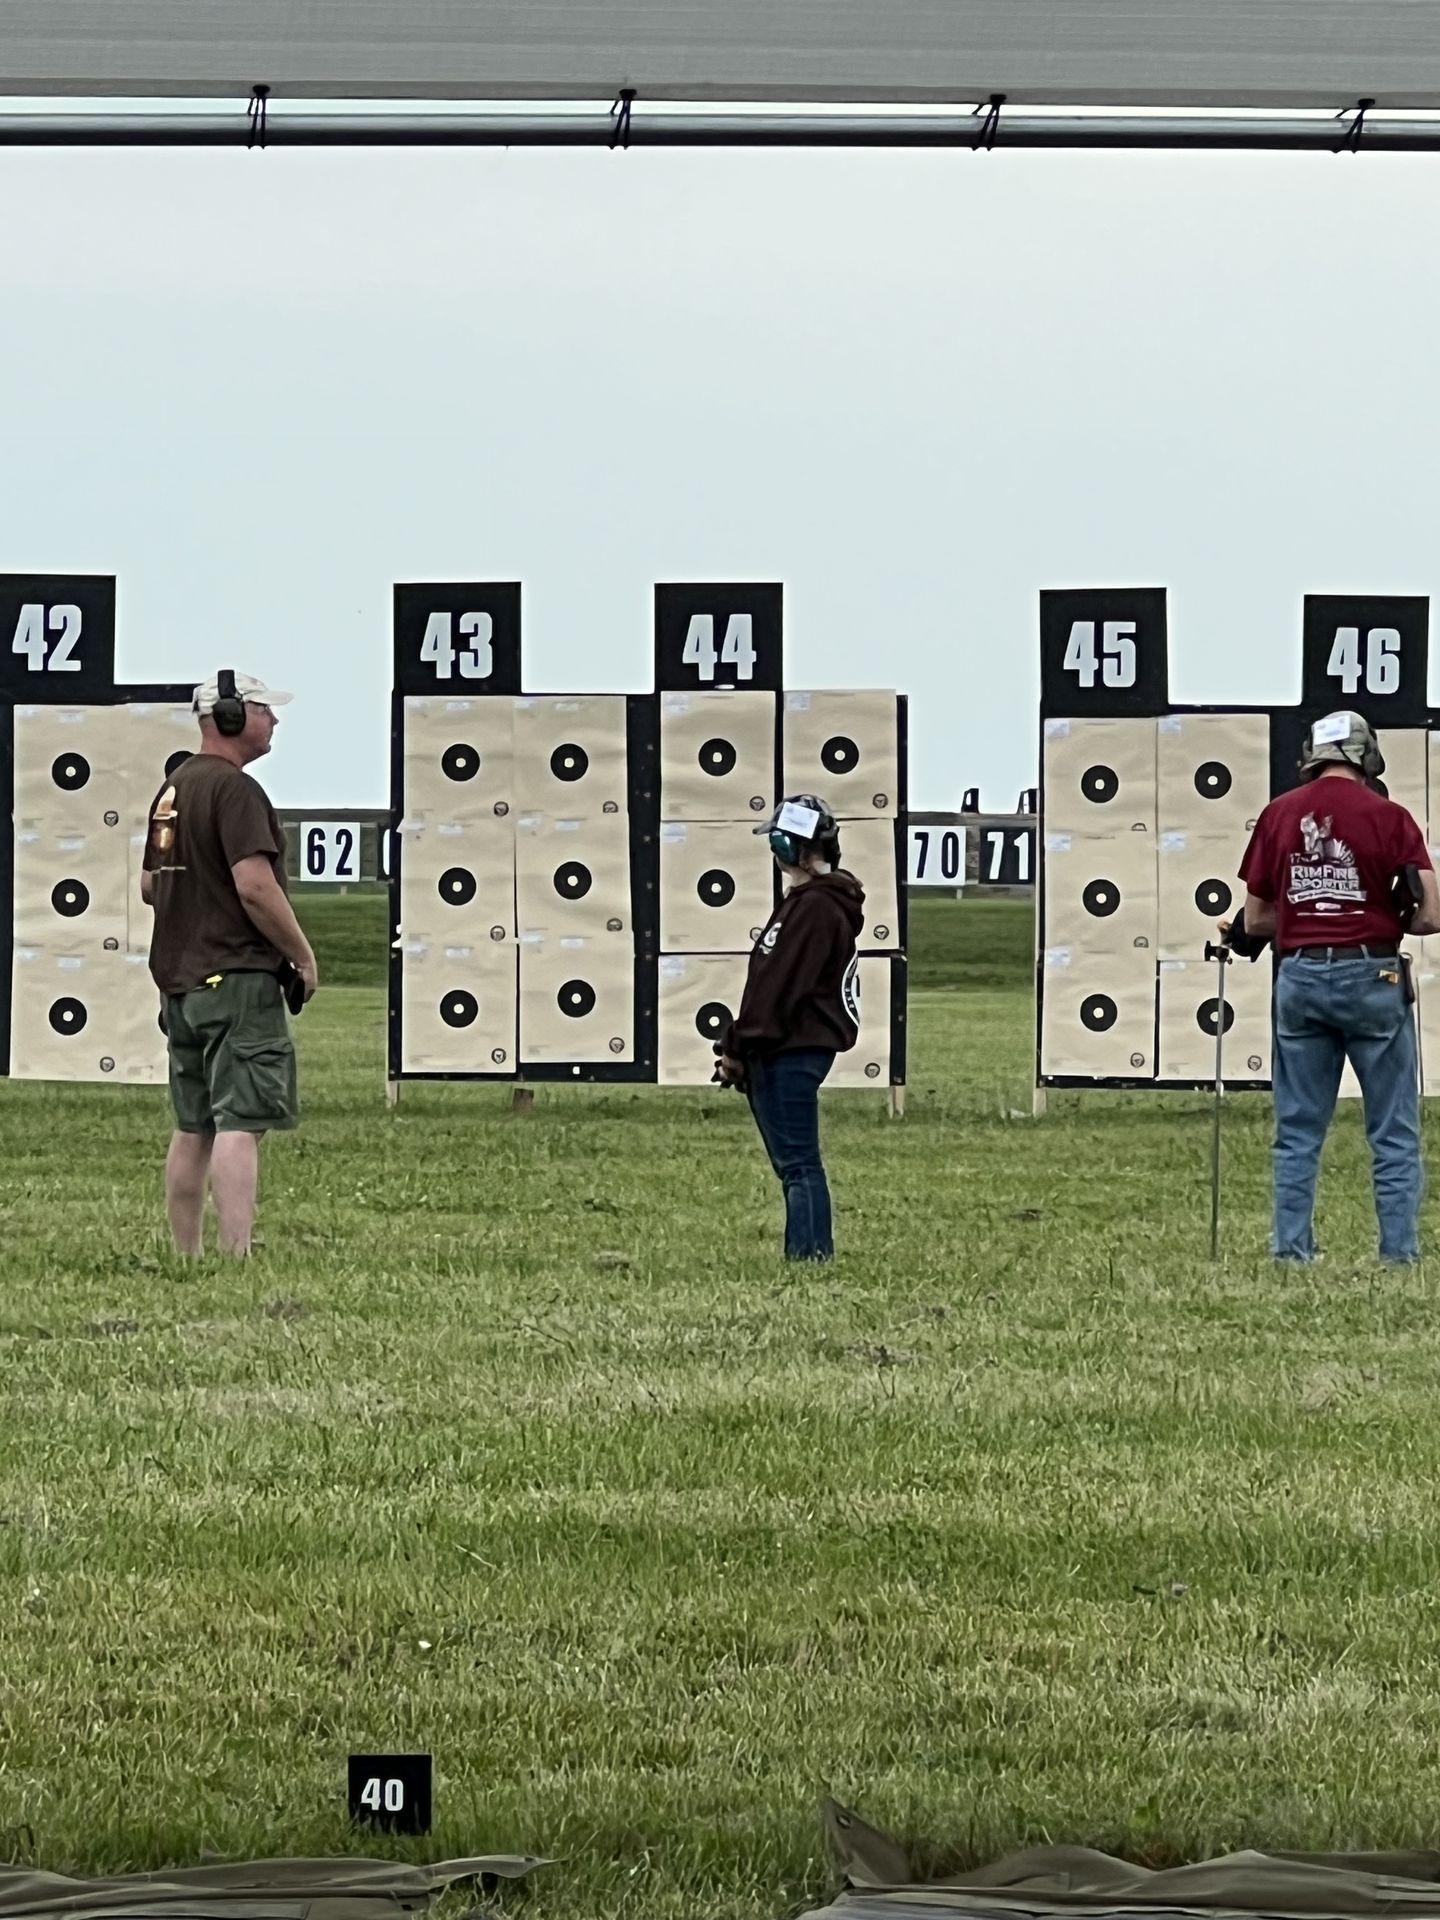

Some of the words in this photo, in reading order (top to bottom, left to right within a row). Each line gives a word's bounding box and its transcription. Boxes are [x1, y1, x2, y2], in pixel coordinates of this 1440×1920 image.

[11, 603, 83, 673] 42
[419, 611, 494, 680] 43
[682, 613, 757, 681] 44
[1063, 620, 1138, 689] 45
[1326, 626, 1402, 696] 46
[307, 827, 353, 876] 62
[914, 831, 960, 879] 70
[987, 831, 1030, 880] 71
[1291, 864, 1359, 880] RIMFIRE
[360, 1778, 404, 1812] 40
